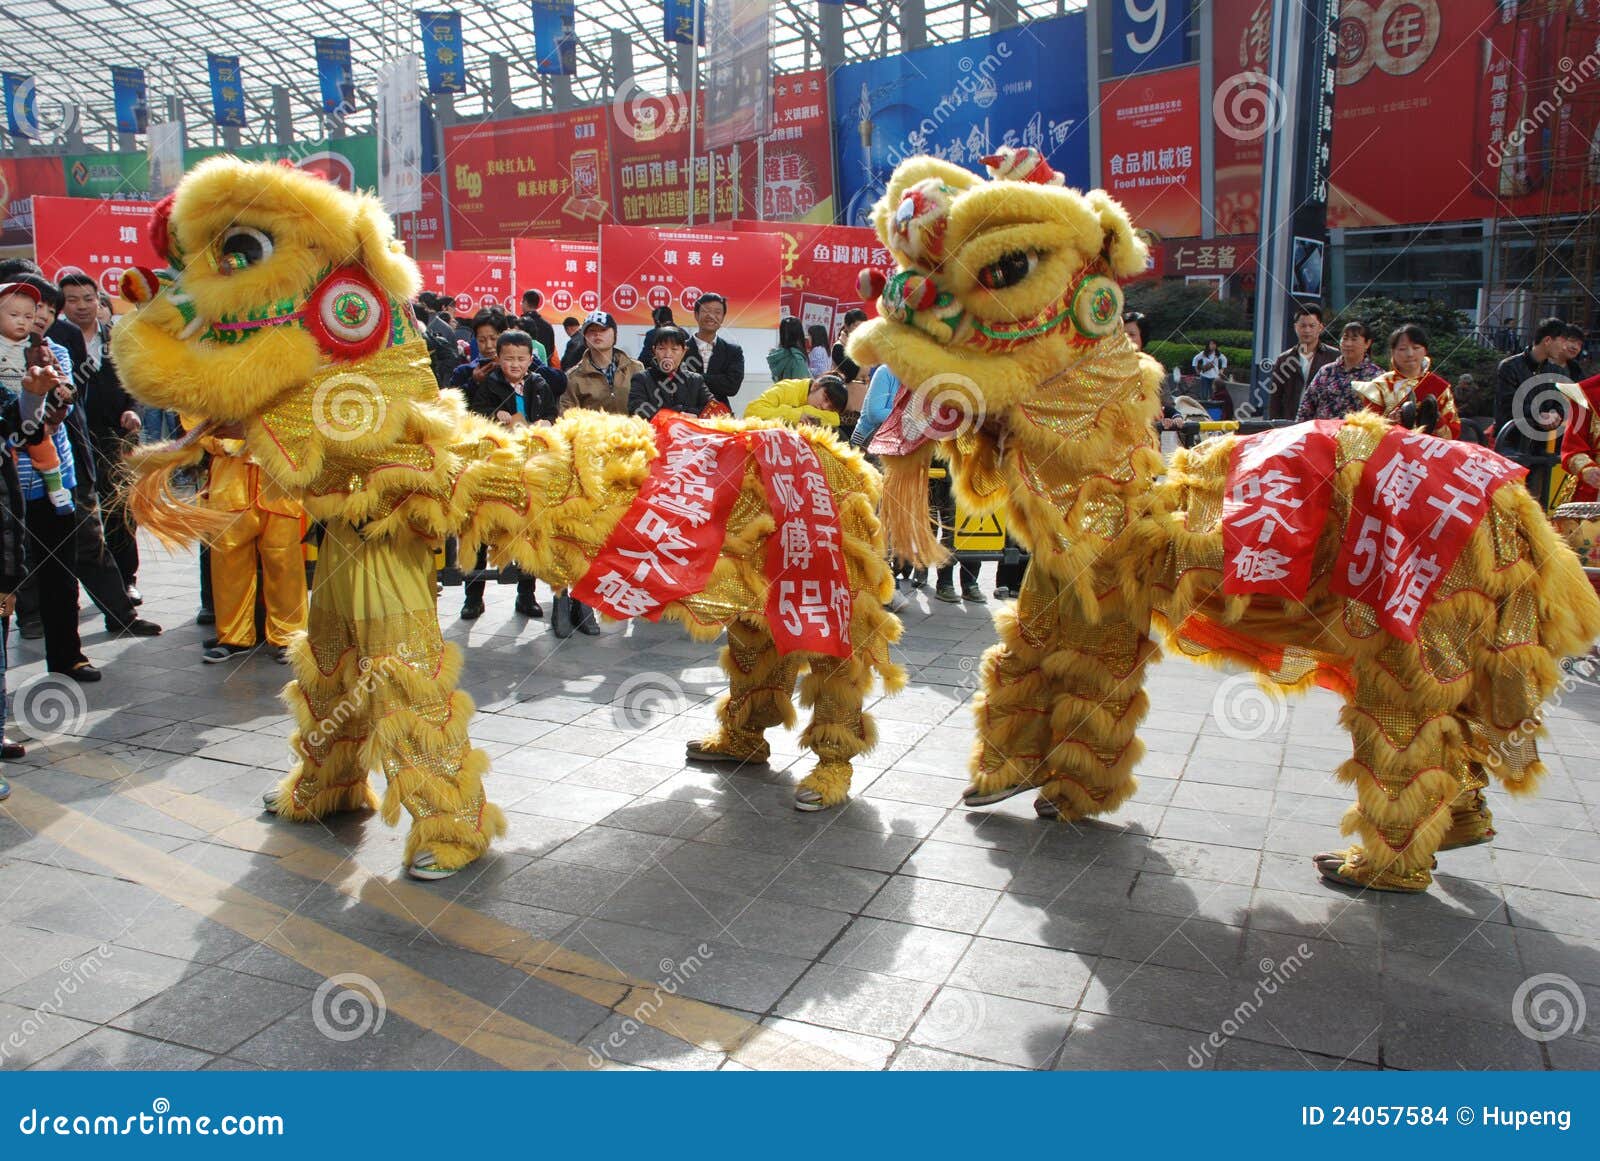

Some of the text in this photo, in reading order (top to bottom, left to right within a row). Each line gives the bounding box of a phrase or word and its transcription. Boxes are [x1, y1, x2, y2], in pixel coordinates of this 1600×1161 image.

[1123, 0, 1167, 55] 9
[1386, 12, 1422, 54] 年
[1110, 146, 1192, 175] 食品机械馆
[1114, 174, 1187, 189] Food Machinery
[664, 250, 725, 266] 填表台
[1174, 246, 1236, 270] 仁圣酱
[1346, 514, 1442, 626] 5号馆
